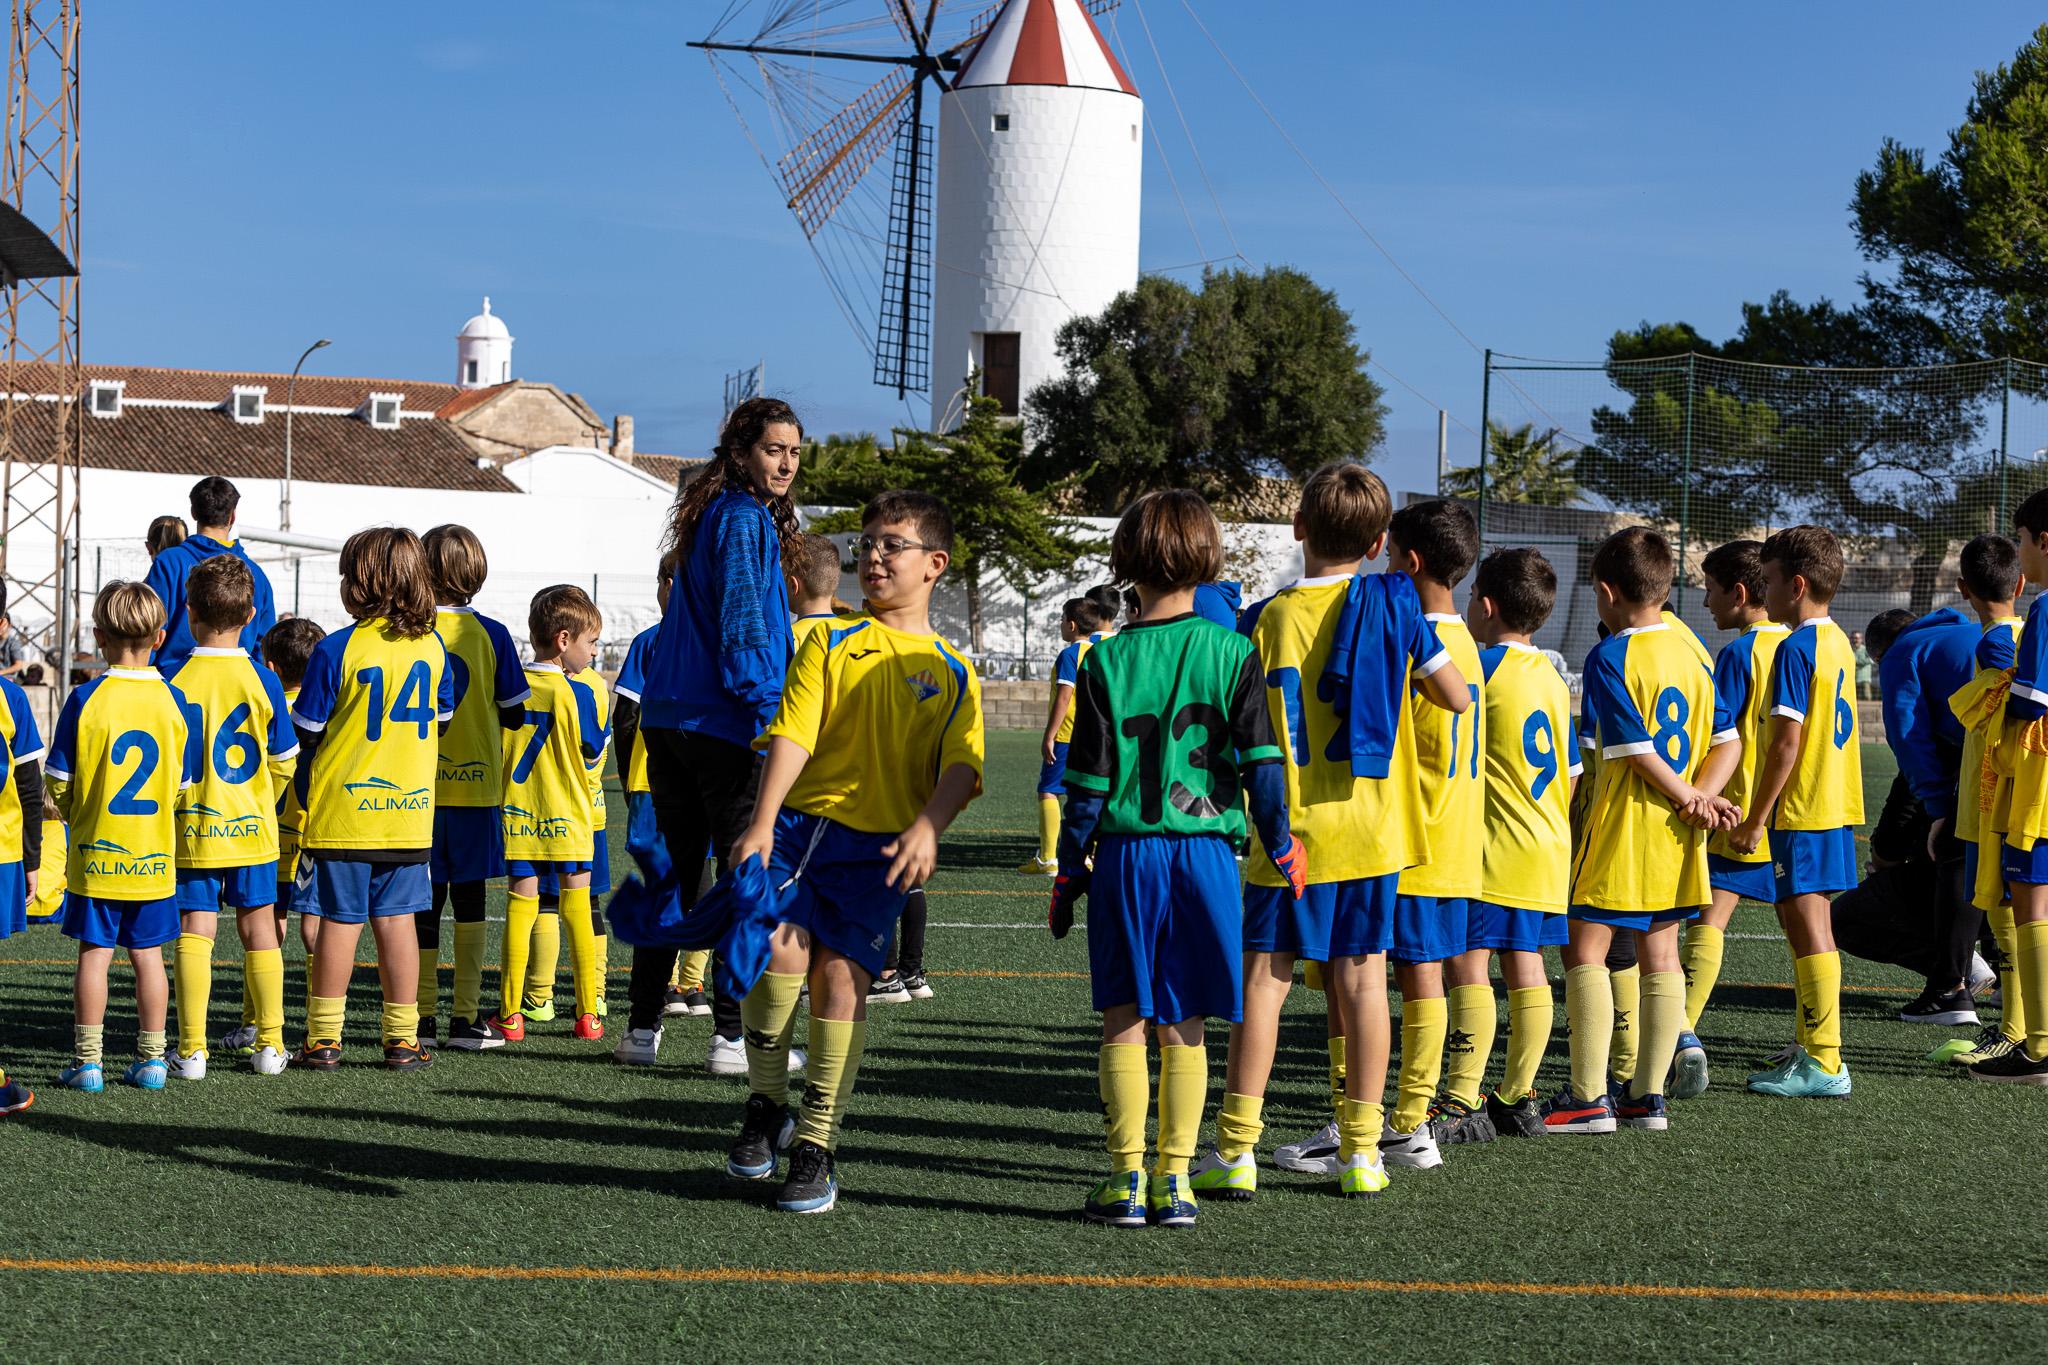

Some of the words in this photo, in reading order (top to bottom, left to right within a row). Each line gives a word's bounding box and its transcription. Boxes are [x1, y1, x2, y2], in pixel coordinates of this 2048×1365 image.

[357, 660, 435, 741] 14
[1448, 684, 1479, 779] 11
[1652, 686, 1690, 775] 8
[1834, 668, 1854, 750] 6
[108, 730, 159, 815] 2
[188, 702, 262, 785] 16
[435, 770, 485, 782] IMAR
[512, 710, 555, 785] 7
[1121, 702, 1239, 825] 13
[1522, 709, 1557, 801] 9
[183, 824, 259, 838] ALIMAR
[357, 797, 429, 811] ALIMAR
[85, 861, 166, 875] ALIMAR
